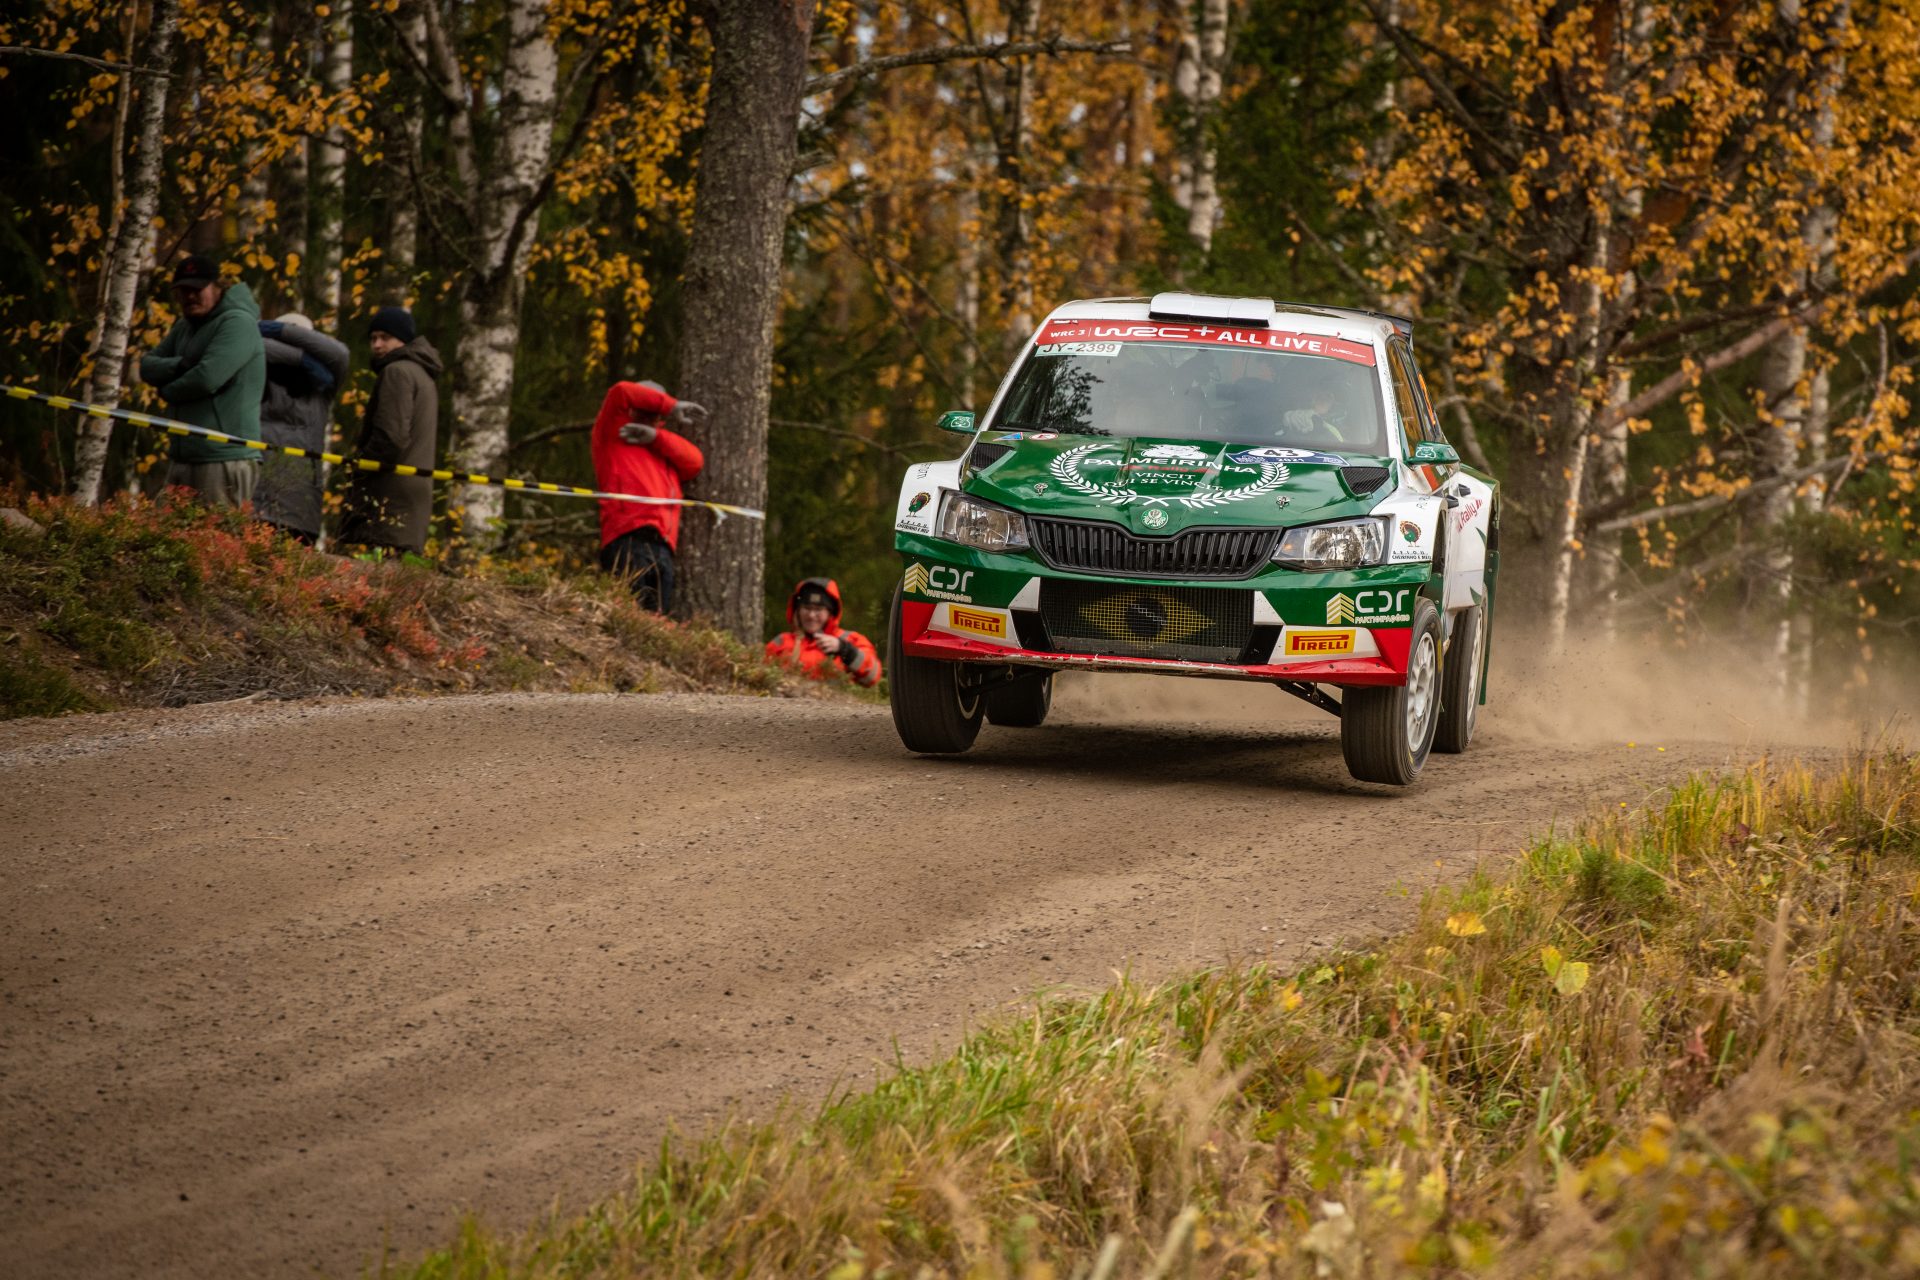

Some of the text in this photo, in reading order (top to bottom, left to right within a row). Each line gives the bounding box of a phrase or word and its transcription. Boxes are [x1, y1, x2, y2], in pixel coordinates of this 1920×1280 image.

[1050, 329, 1075, 338] WRC
[1217, 331, 1262, 345] ALL
[1269, 335, 1322, 352] LIVE
[1263, 449, 1299, 457] 43
[1083, 457, 1257, 475] PALMEIRINHA
[1135, 472, 1196, 480] VINCIT
[1104, 478, 1135, 488] QUI
[953, 609, 1001, 633] PIRELLI
[1292, 634, 1350, 651] PIRELLI
